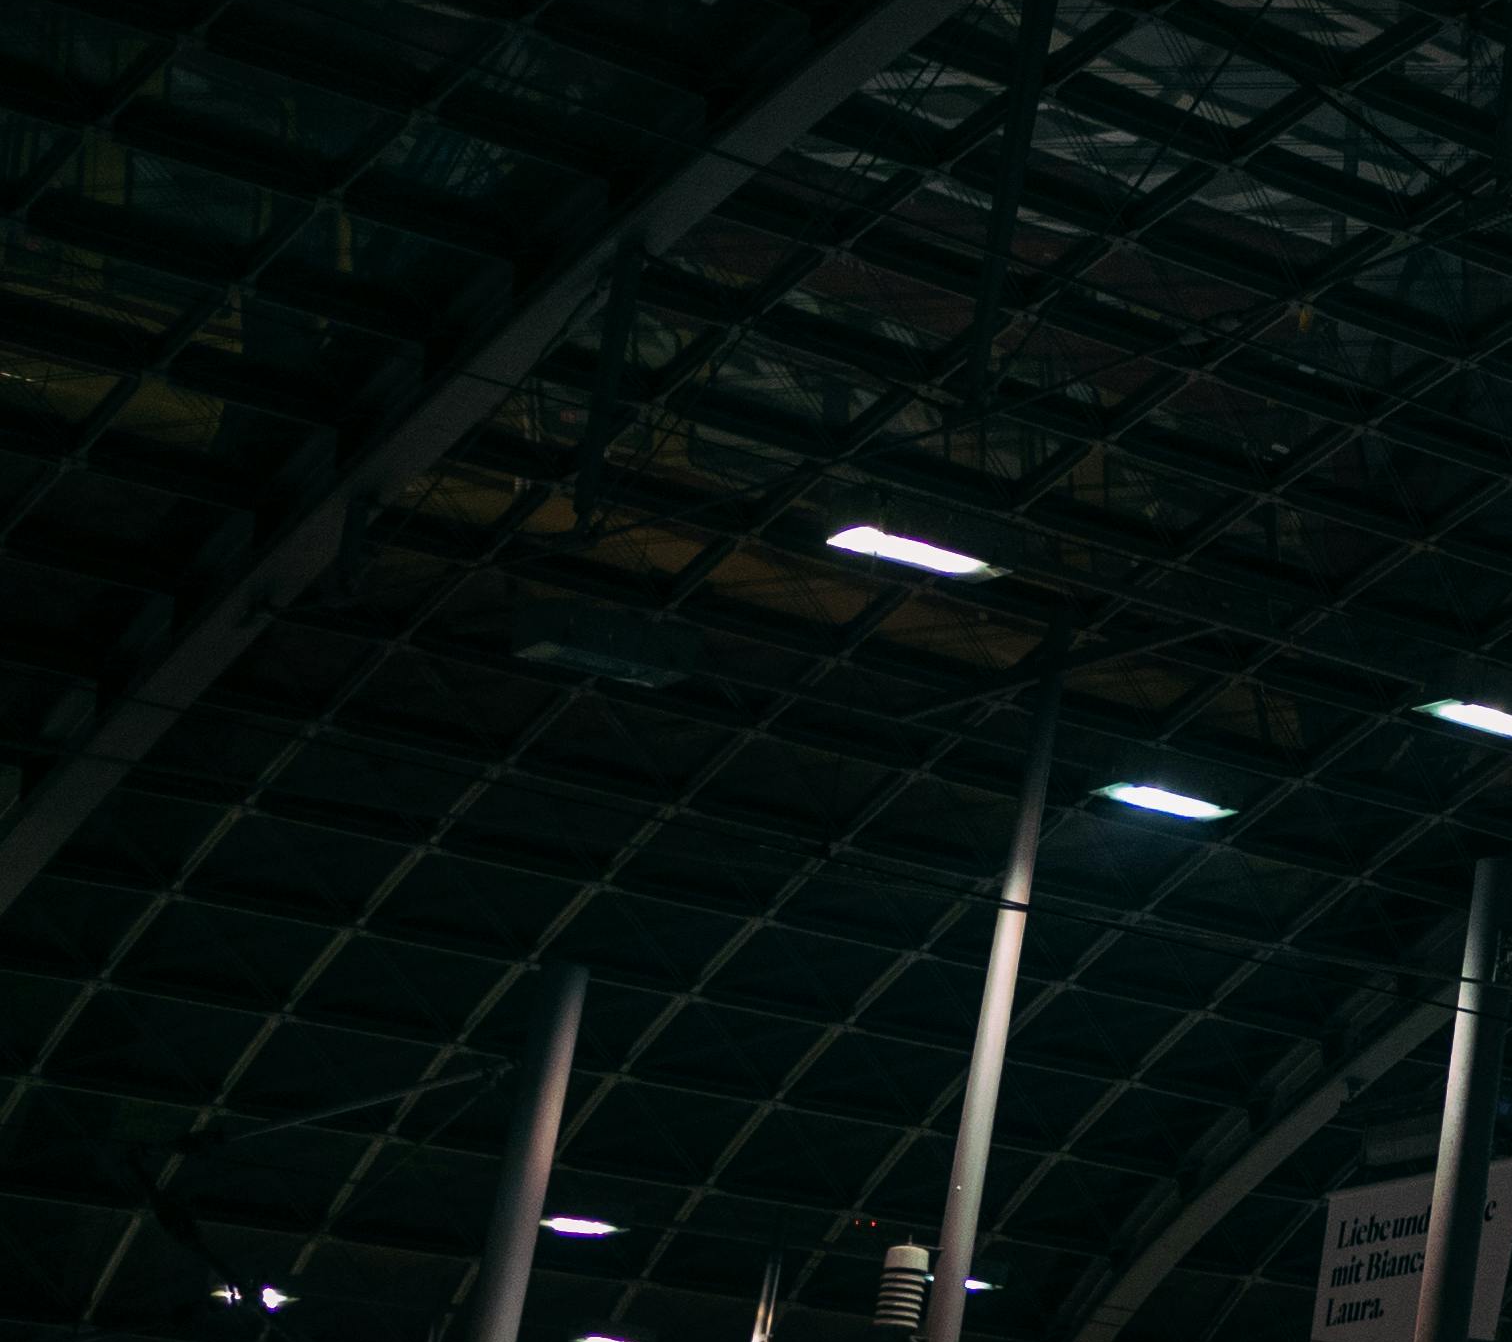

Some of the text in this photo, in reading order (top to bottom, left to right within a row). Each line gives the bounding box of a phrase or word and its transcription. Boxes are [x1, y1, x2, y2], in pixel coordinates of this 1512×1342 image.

[1337, 1214, 1391, 1249] Liebe
[1330, 1249, 1426, 1288] mit Bianc
[1325, 1297, 1385, 1327] Laura.
